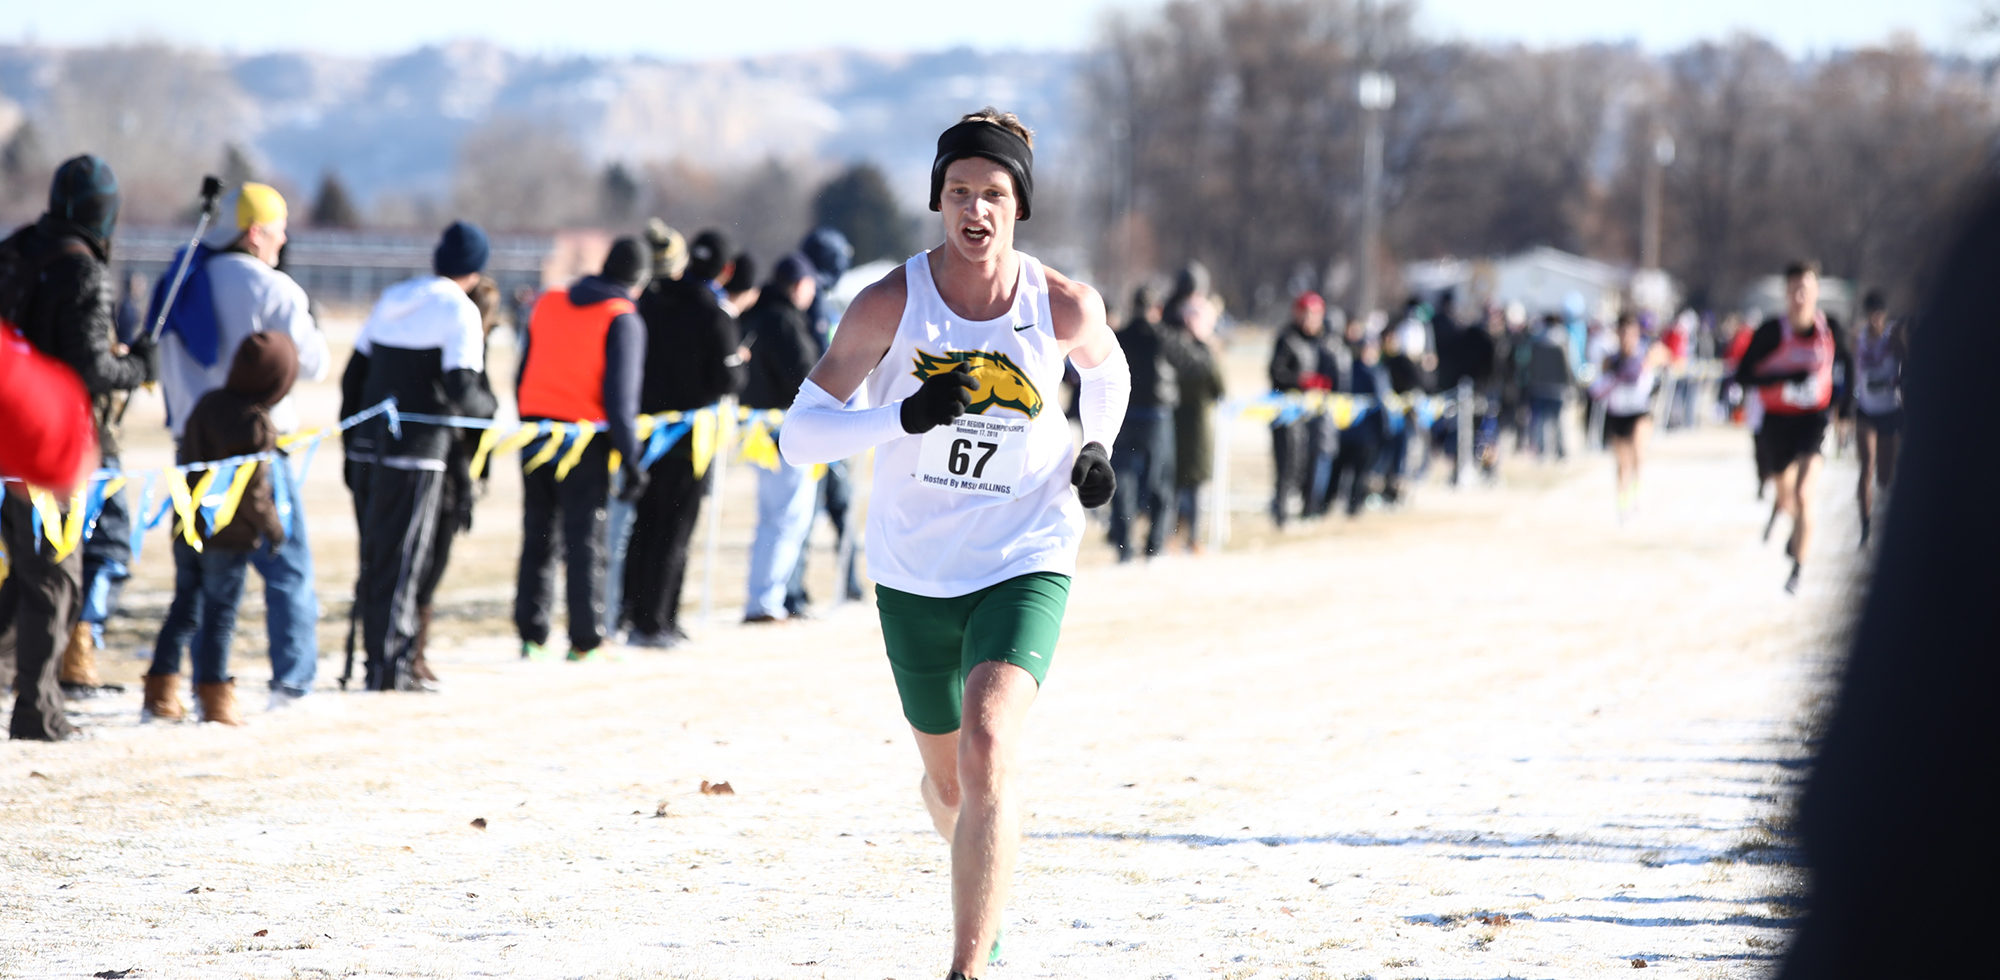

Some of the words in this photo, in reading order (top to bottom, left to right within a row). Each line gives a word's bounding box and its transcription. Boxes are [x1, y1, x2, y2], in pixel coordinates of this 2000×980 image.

[956, 427, 978, 435] November
[967, 420, 985, 430] REGION
[948, 438, 998, 478] 67
[923, 474, 948, 485] Hosted
[950, 478, 959, 488] By
[960, 481, 977, 490] MSU
[978, 483, 1011, 494] BILLINGS
